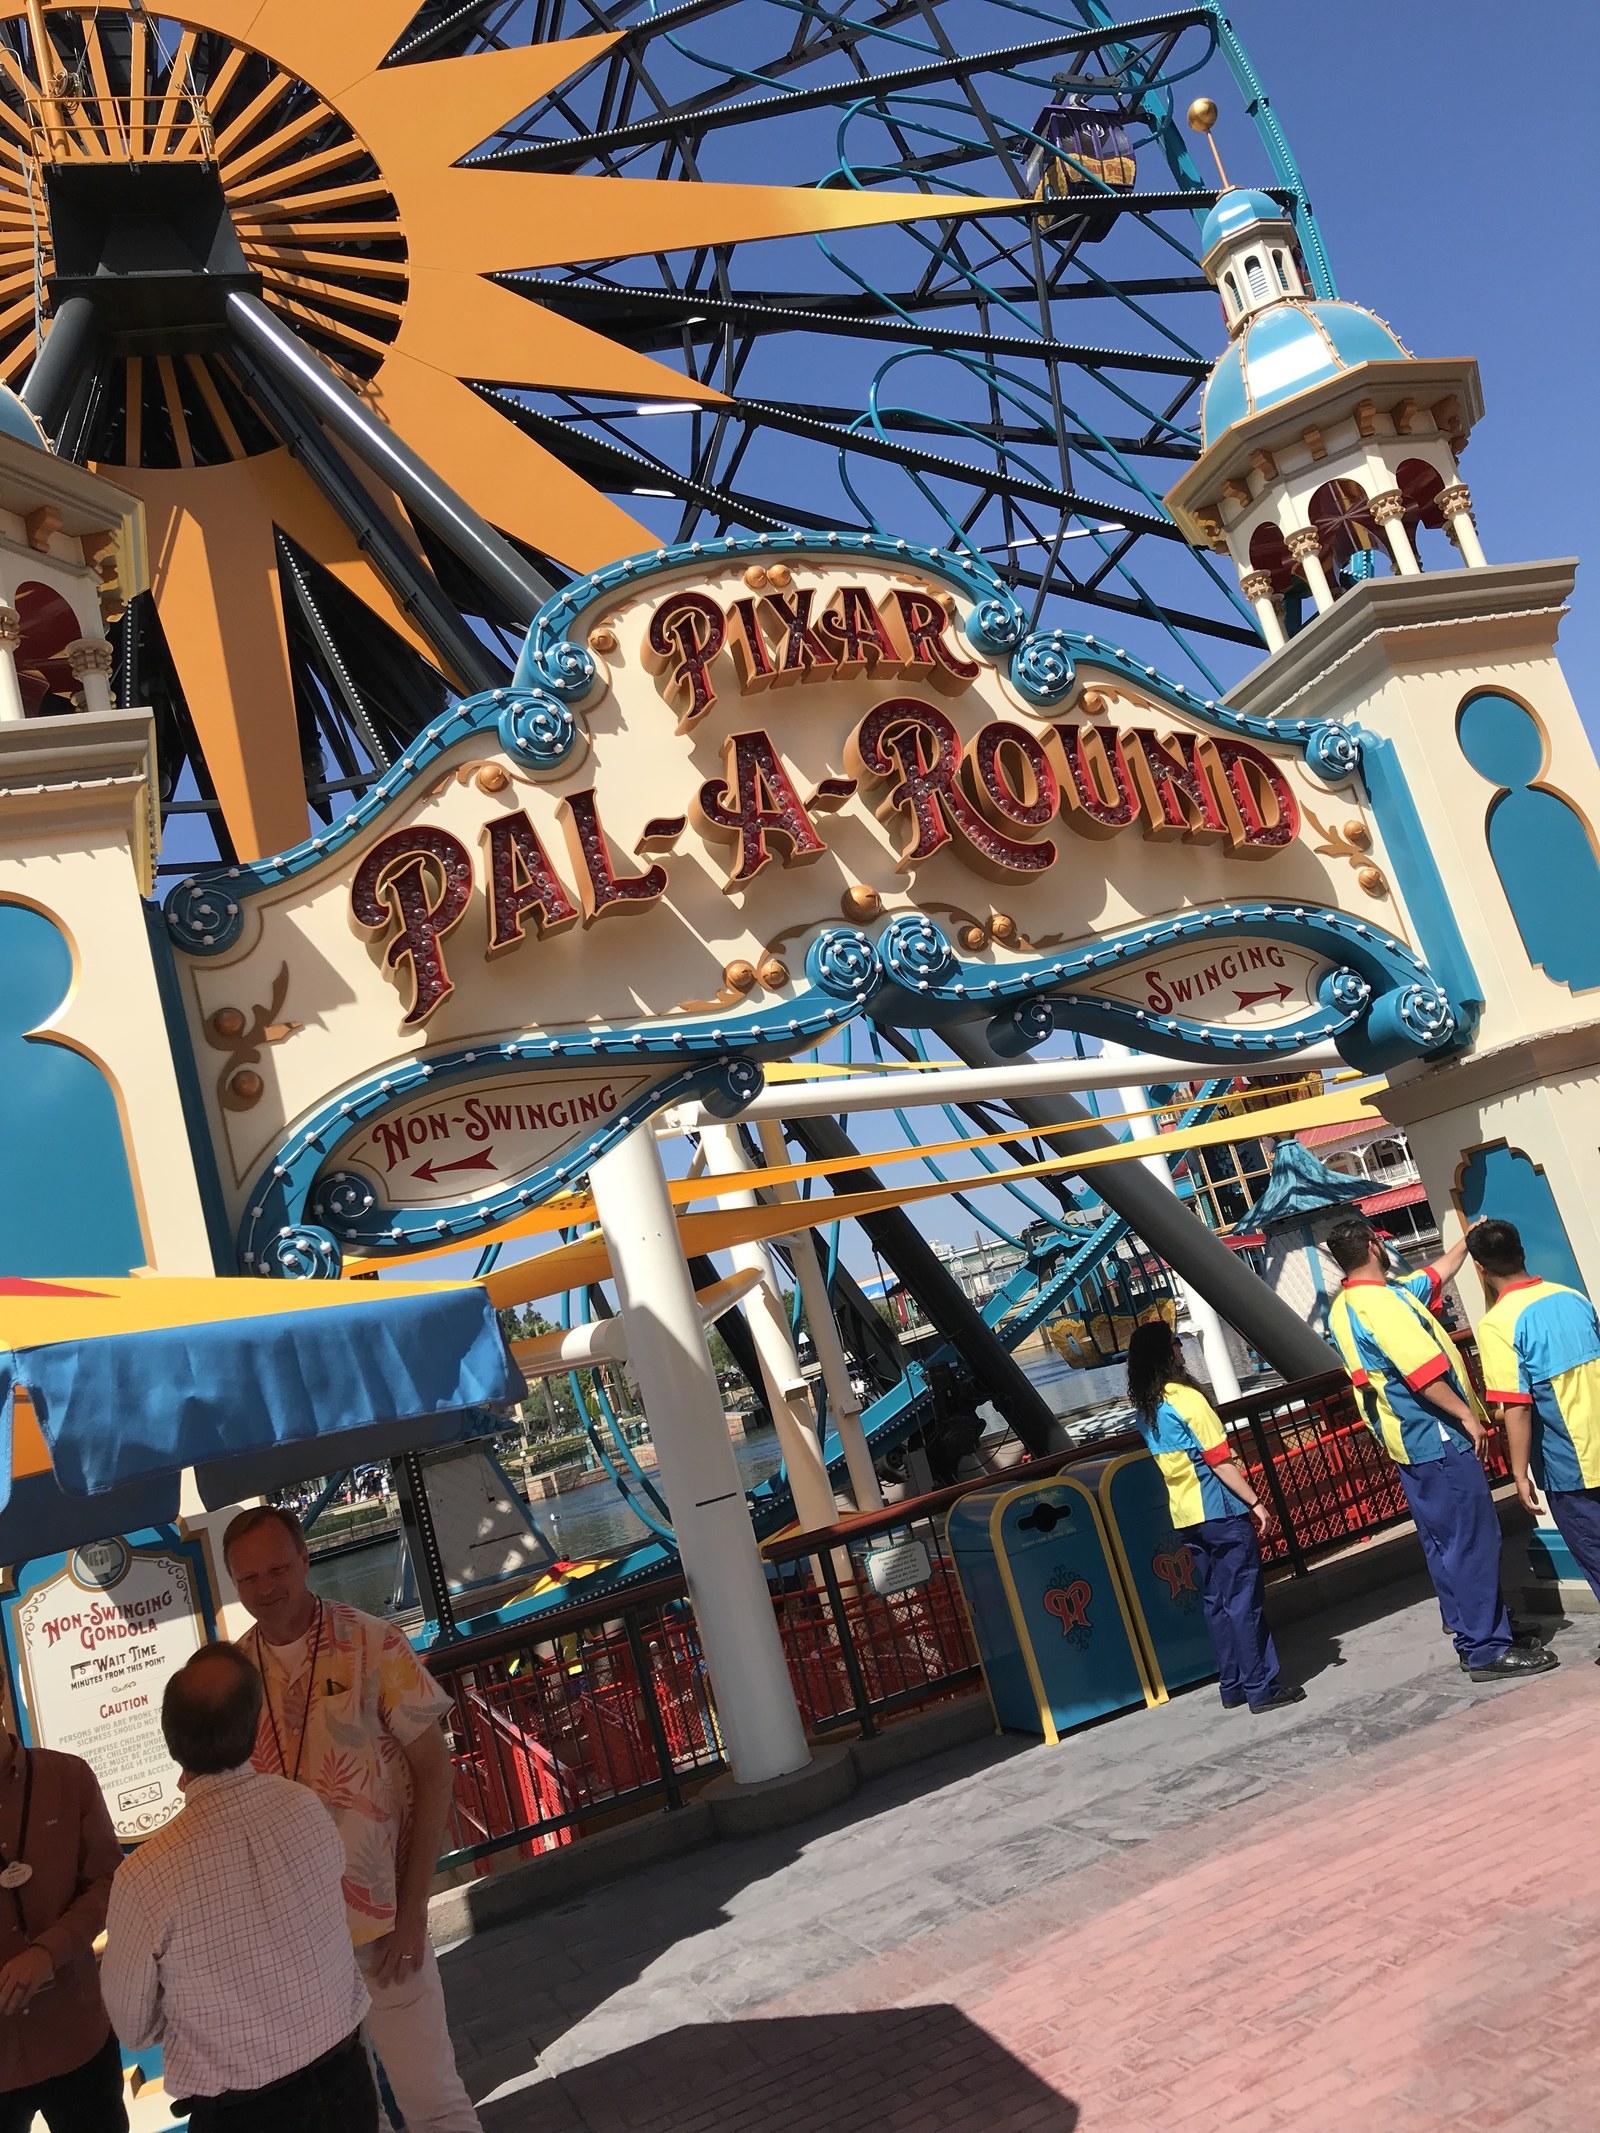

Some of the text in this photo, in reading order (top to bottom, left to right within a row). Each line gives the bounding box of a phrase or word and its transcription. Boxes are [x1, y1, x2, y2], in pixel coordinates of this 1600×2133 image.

[649, 587, 981, 718] PIXAR
[351, 697, 1300, 1023] PAL-A-ROUND
[1145, 946, 1286, 1015] SWINGING
[372, 1084, 618, 1172] NON-SWINGING
[42, 1590, 173, 1648] NON-SWINGING
[80, 1618, 158, 1650] GONDOLA
[70, 1656, 166, 1691] MINUTES FROM THIS POINT
[92, 1644, 157, 1673] WAIT TIME
[100, 1695, 149, 1718] CAUTION
[59, 1729, 92, 1744] PERSONS
[93, 1723, 111, 1734] WHO
[113, 1718, 127, 1728] ARE
[128, 1710, 153, 1721] PRONE
[77, 1716, 158, 1747] SICKNESS SHOULD NOT
[120, 1731, 155, 1746] CHILDREN
[95, 1767, 119, 1779] ERSON
[120, 1762, 136, 1771] AGE
[144, 1752, 167, 1764] YEARS
[106, 1743, 142, 1759] CHILDREN
[109, 1755, 130, 1766] MUST
[131, 1752, 141, 1760] BE
[147, 1762, 174, 1776] ACCESS
